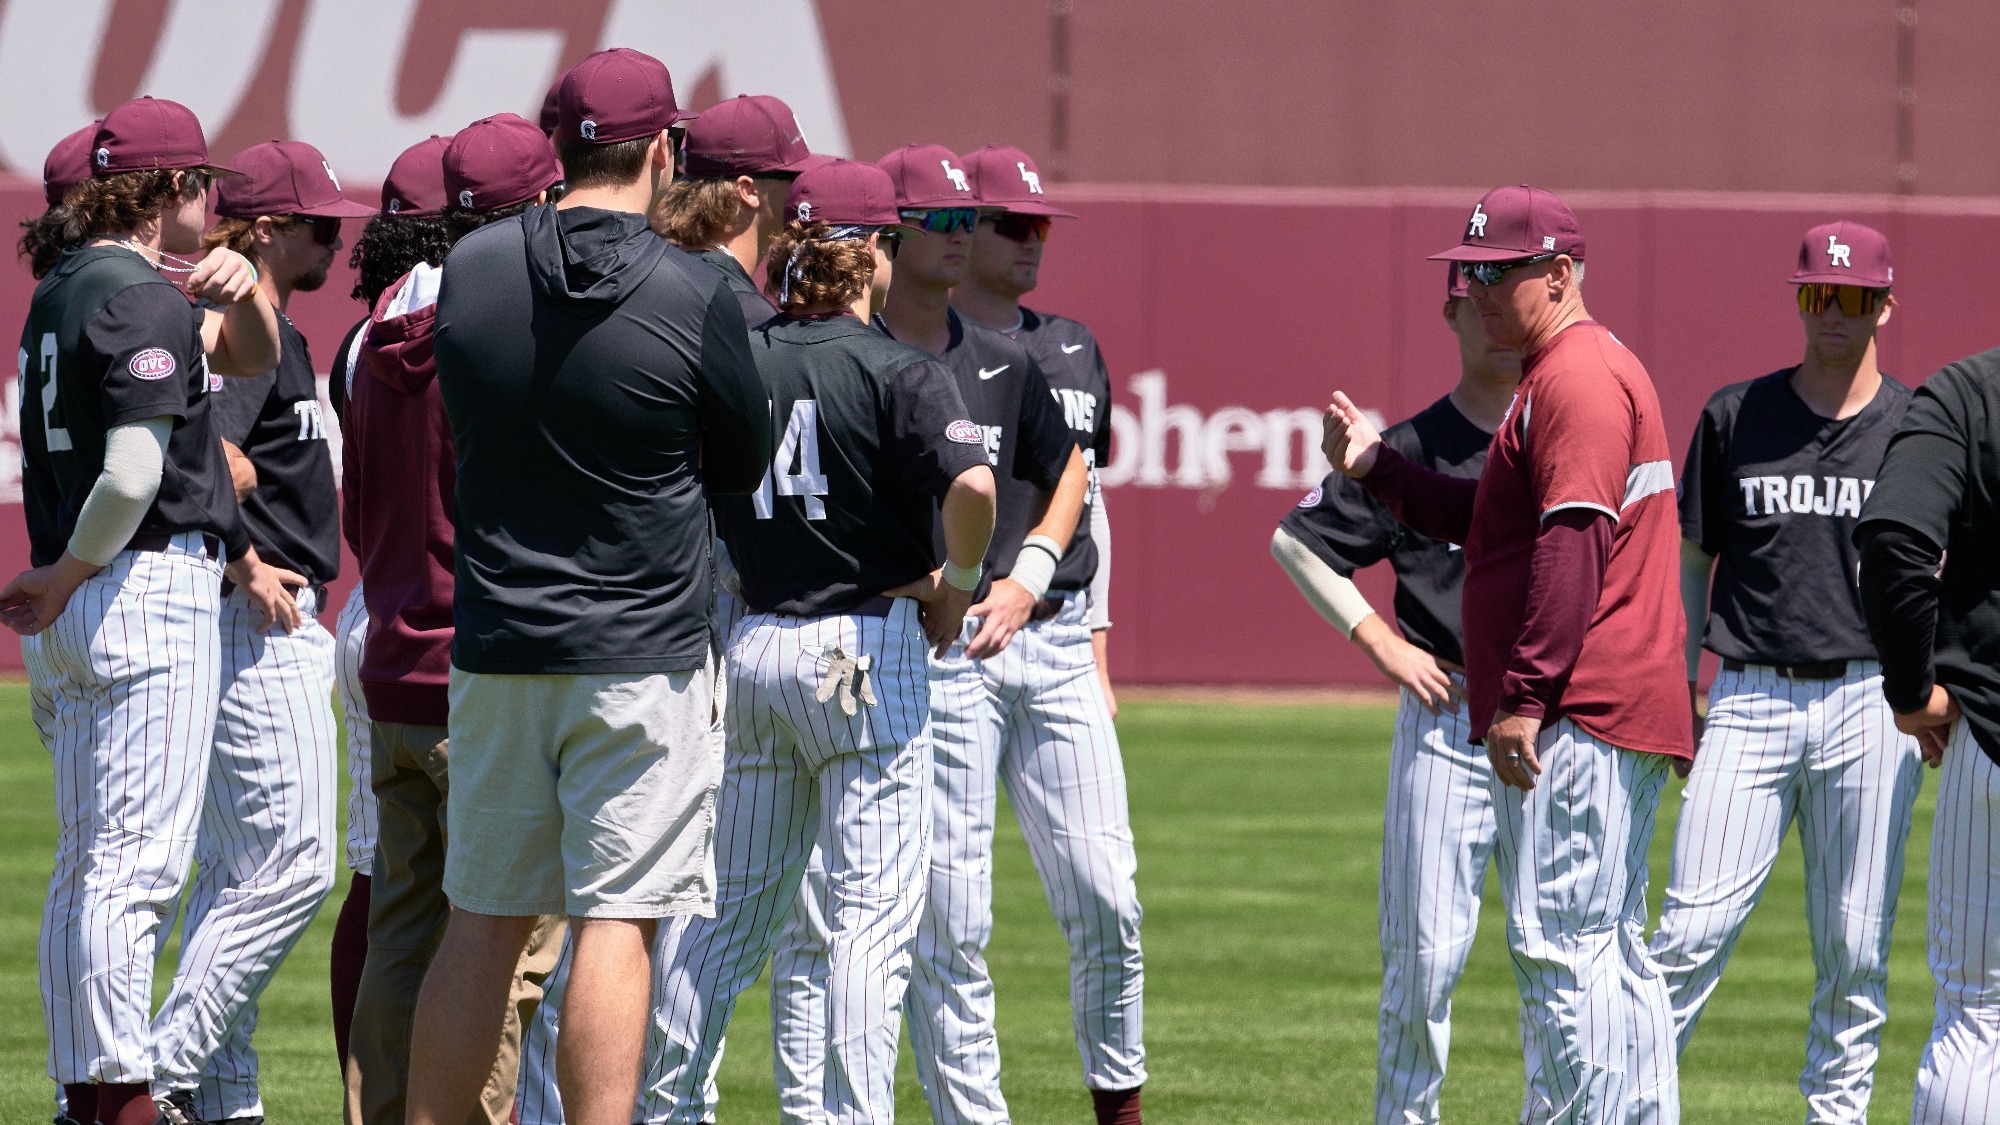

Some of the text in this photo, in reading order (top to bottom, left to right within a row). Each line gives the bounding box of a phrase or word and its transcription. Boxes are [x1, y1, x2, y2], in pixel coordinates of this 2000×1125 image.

[1827, 235, 1851, 268] LR
[1049, 388, 1097, 434] NS
[1100, 368, 1386, 490] hen
[1739, 474, 1876, 519] TROJA
